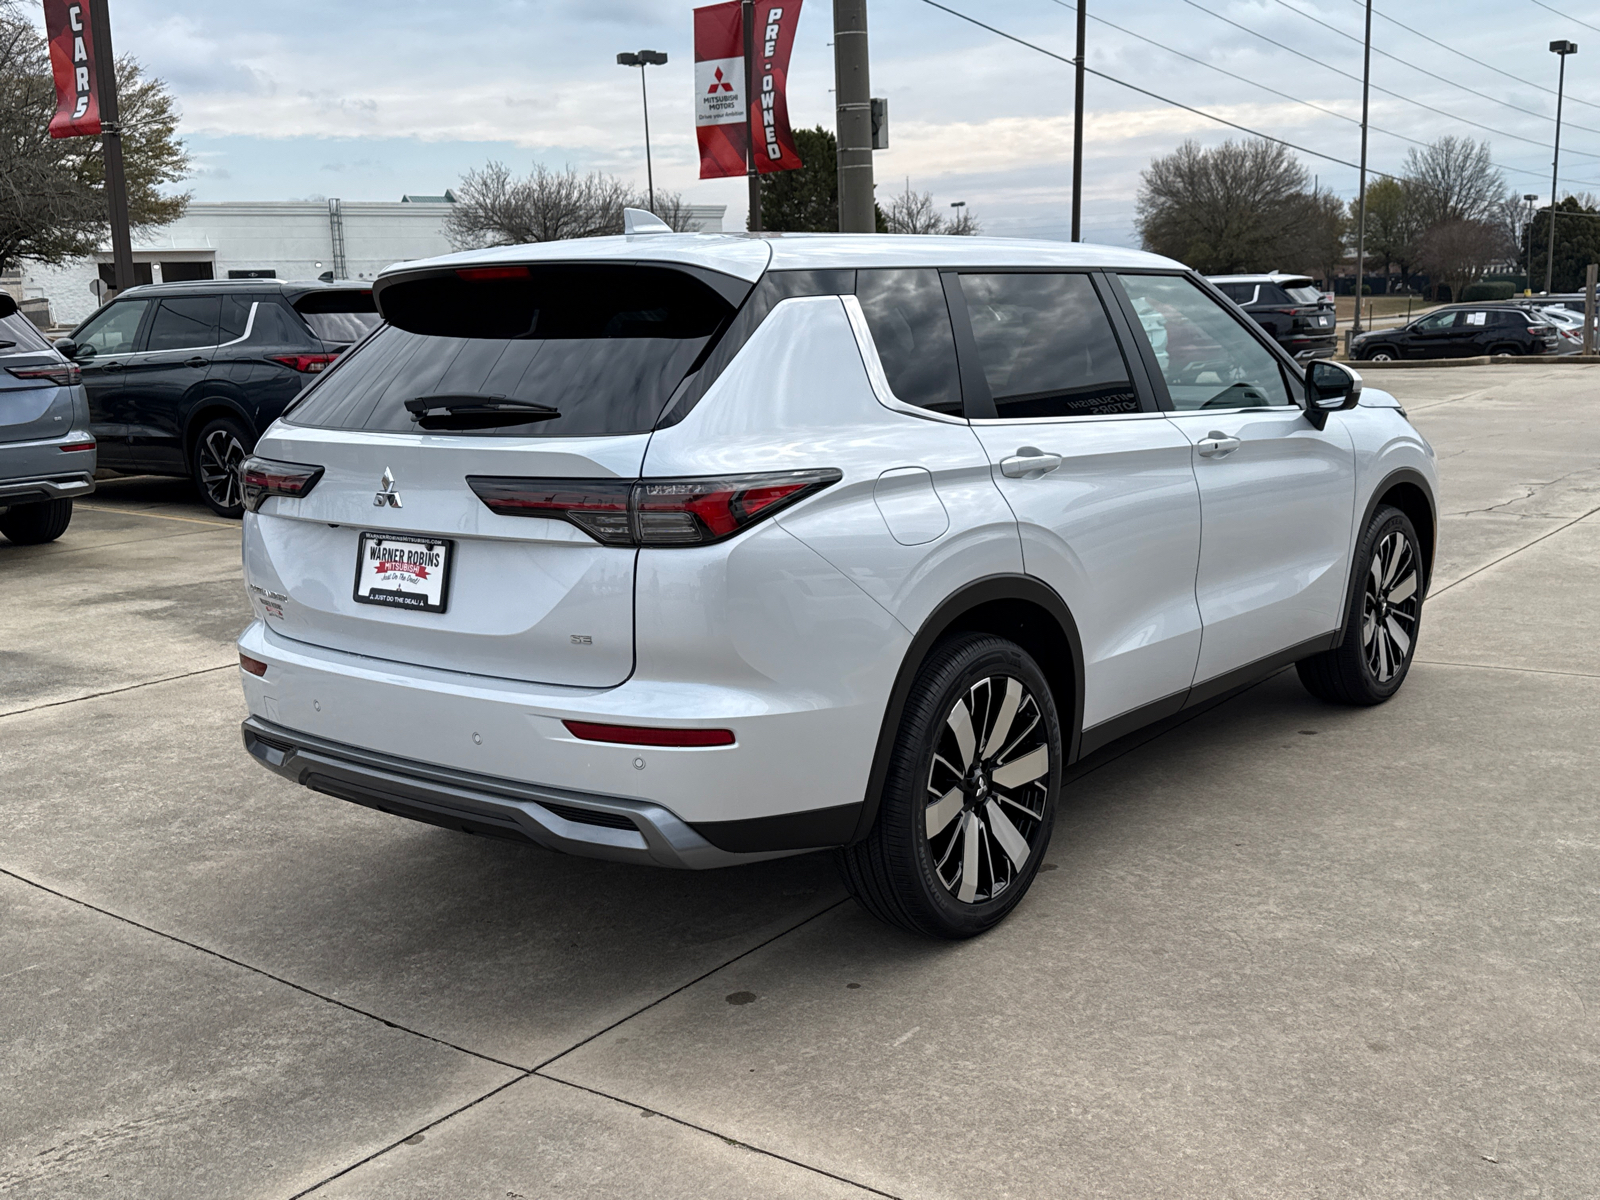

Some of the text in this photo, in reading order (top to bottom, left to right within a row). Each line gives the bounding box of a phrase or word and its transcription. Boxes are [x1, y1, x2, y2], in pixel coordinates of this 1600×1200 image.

[69, 5, 91, 119] CARS
[704, 94, 738, 104] MITSUBISHI
[709, 102, 735, 111] MOTORS
[370, 546, 440, 567] WARNER ROBINS
[384, 562, 420, 574] MITSUBISHI
[570, 634, 593, 646] SE
